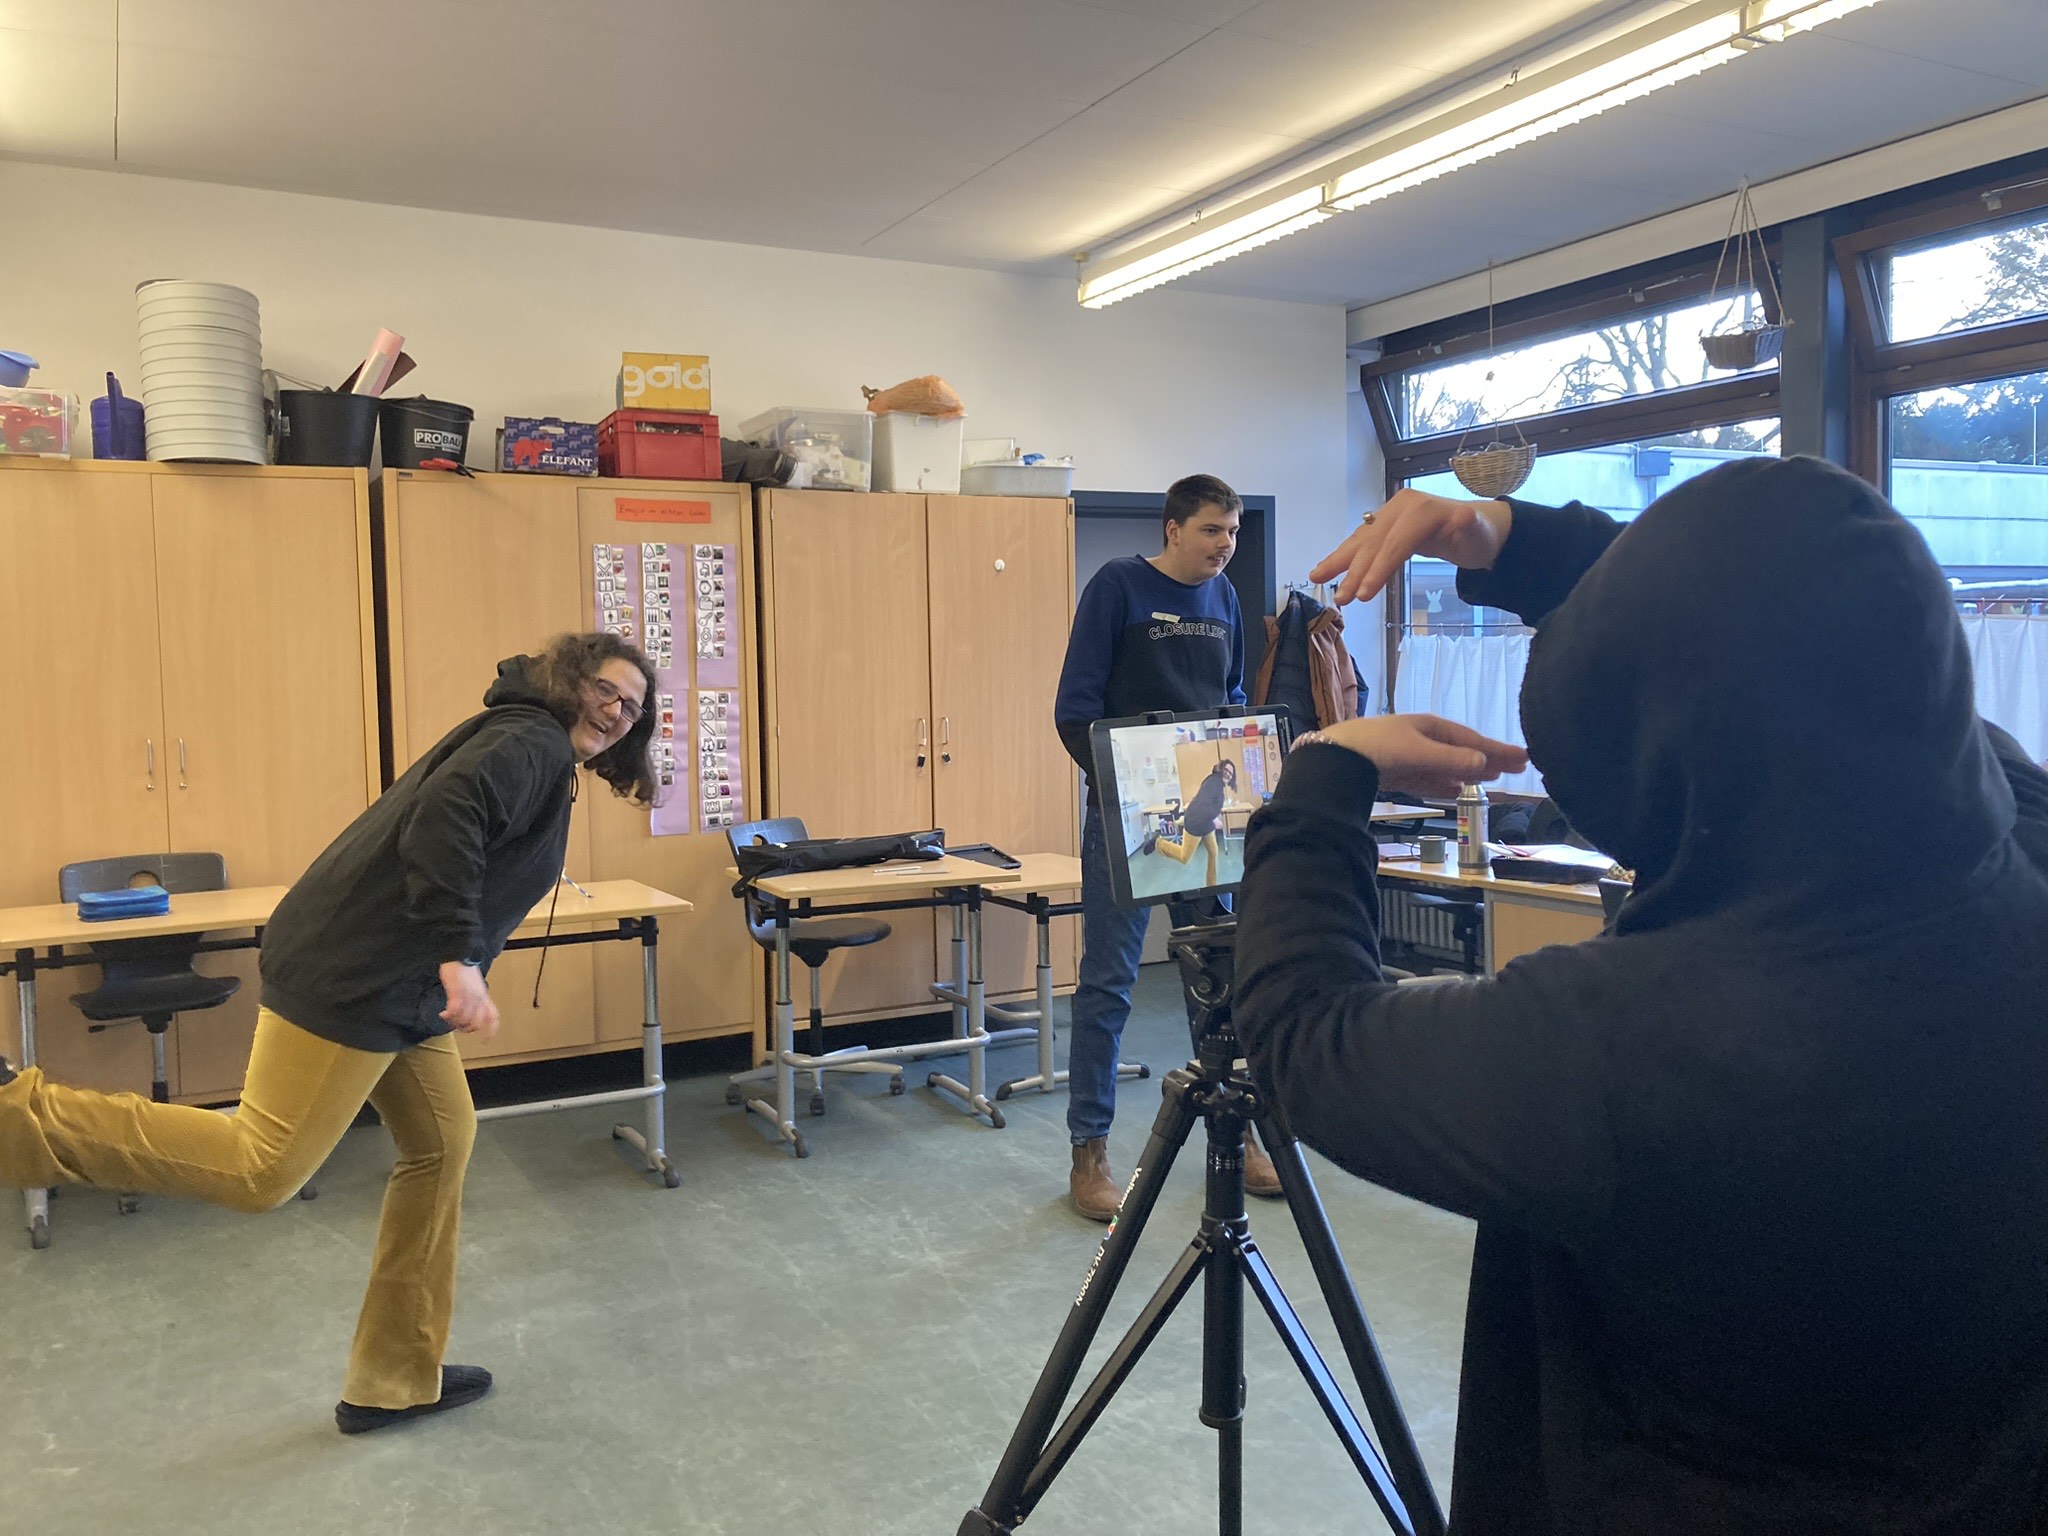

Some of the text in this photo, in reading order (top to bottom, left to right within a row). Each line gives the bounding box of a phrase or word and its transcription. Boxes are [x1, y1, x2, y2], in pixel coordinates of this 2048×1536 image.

[623, 362, 709, 397] gold
[541, 454, 593, 467] ELEFANT
[1149, 622, 1206, 640] CLOSURE
